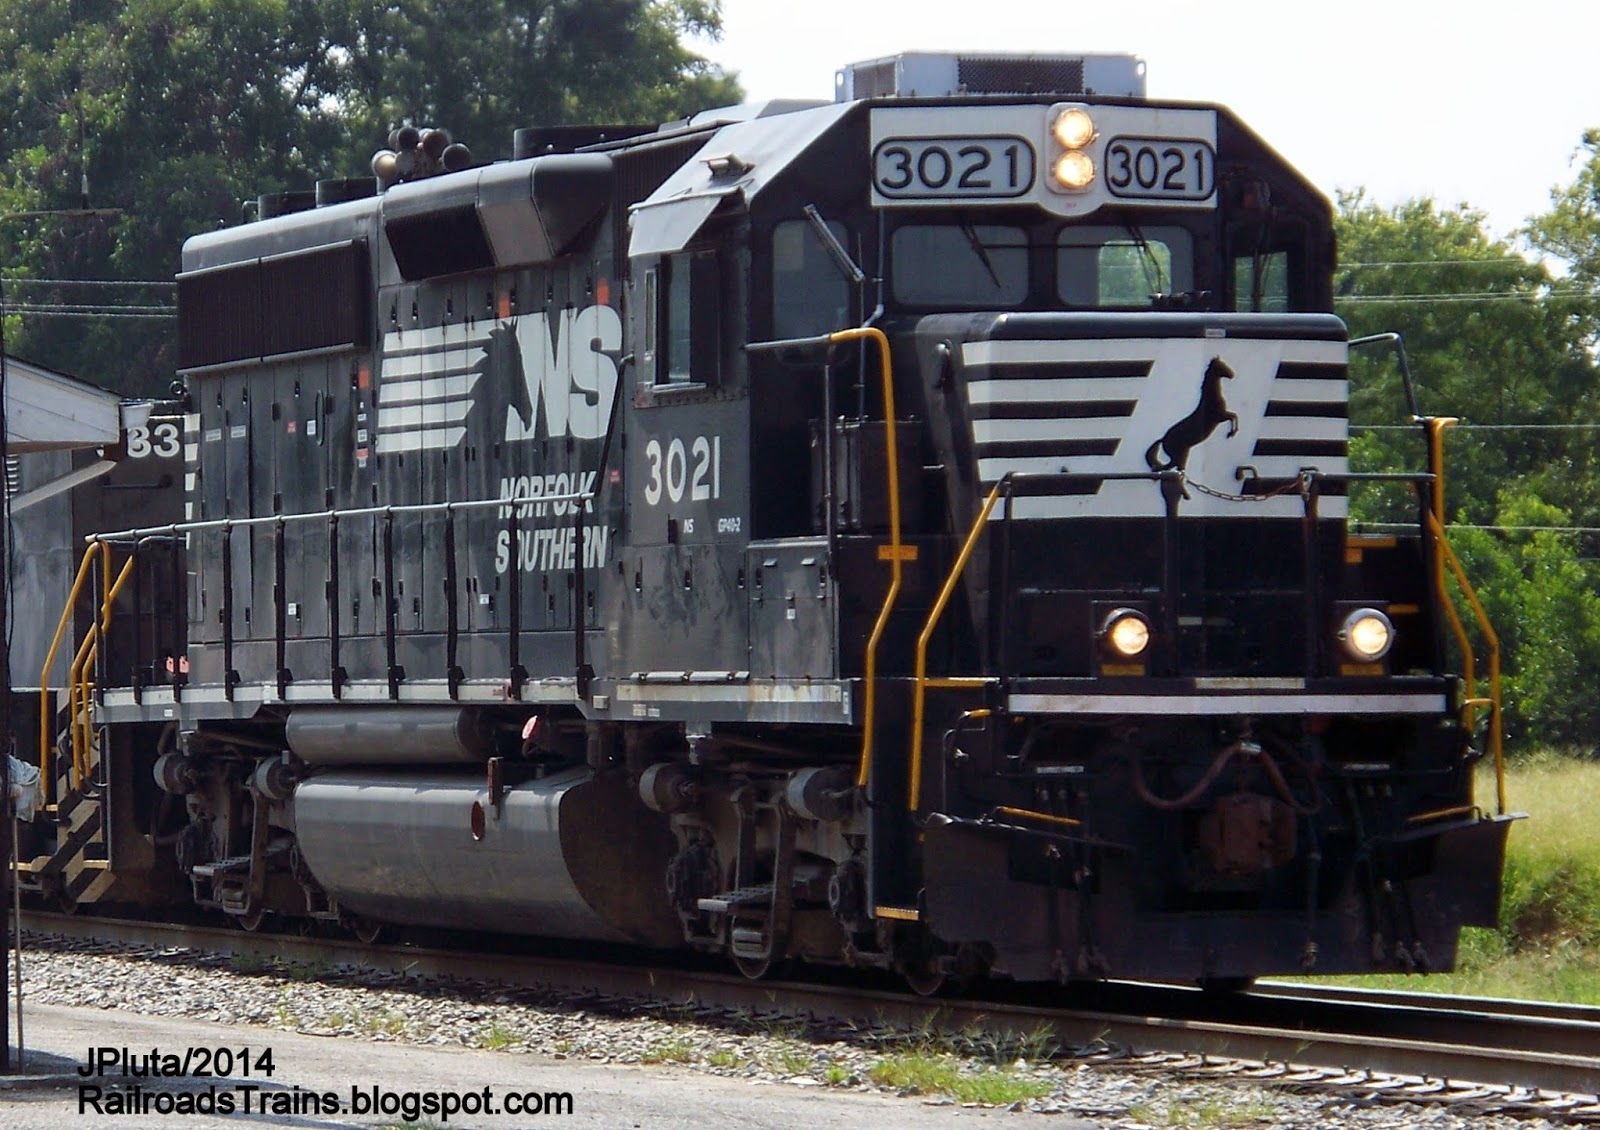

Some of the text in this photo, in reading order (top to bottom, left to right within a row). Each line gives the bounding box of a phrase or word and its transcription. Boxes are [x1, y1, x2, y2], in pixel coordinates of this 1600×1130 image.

[881, 145, 1019, 189] 3021
[1111, 145, 1205, 191] 3021
[505, 305, 622, 442] NS
[645, 436, 721, 506] 3021
[498, 471, 597, 519] NORFOLK
[683, 518, 695, 534] NS
